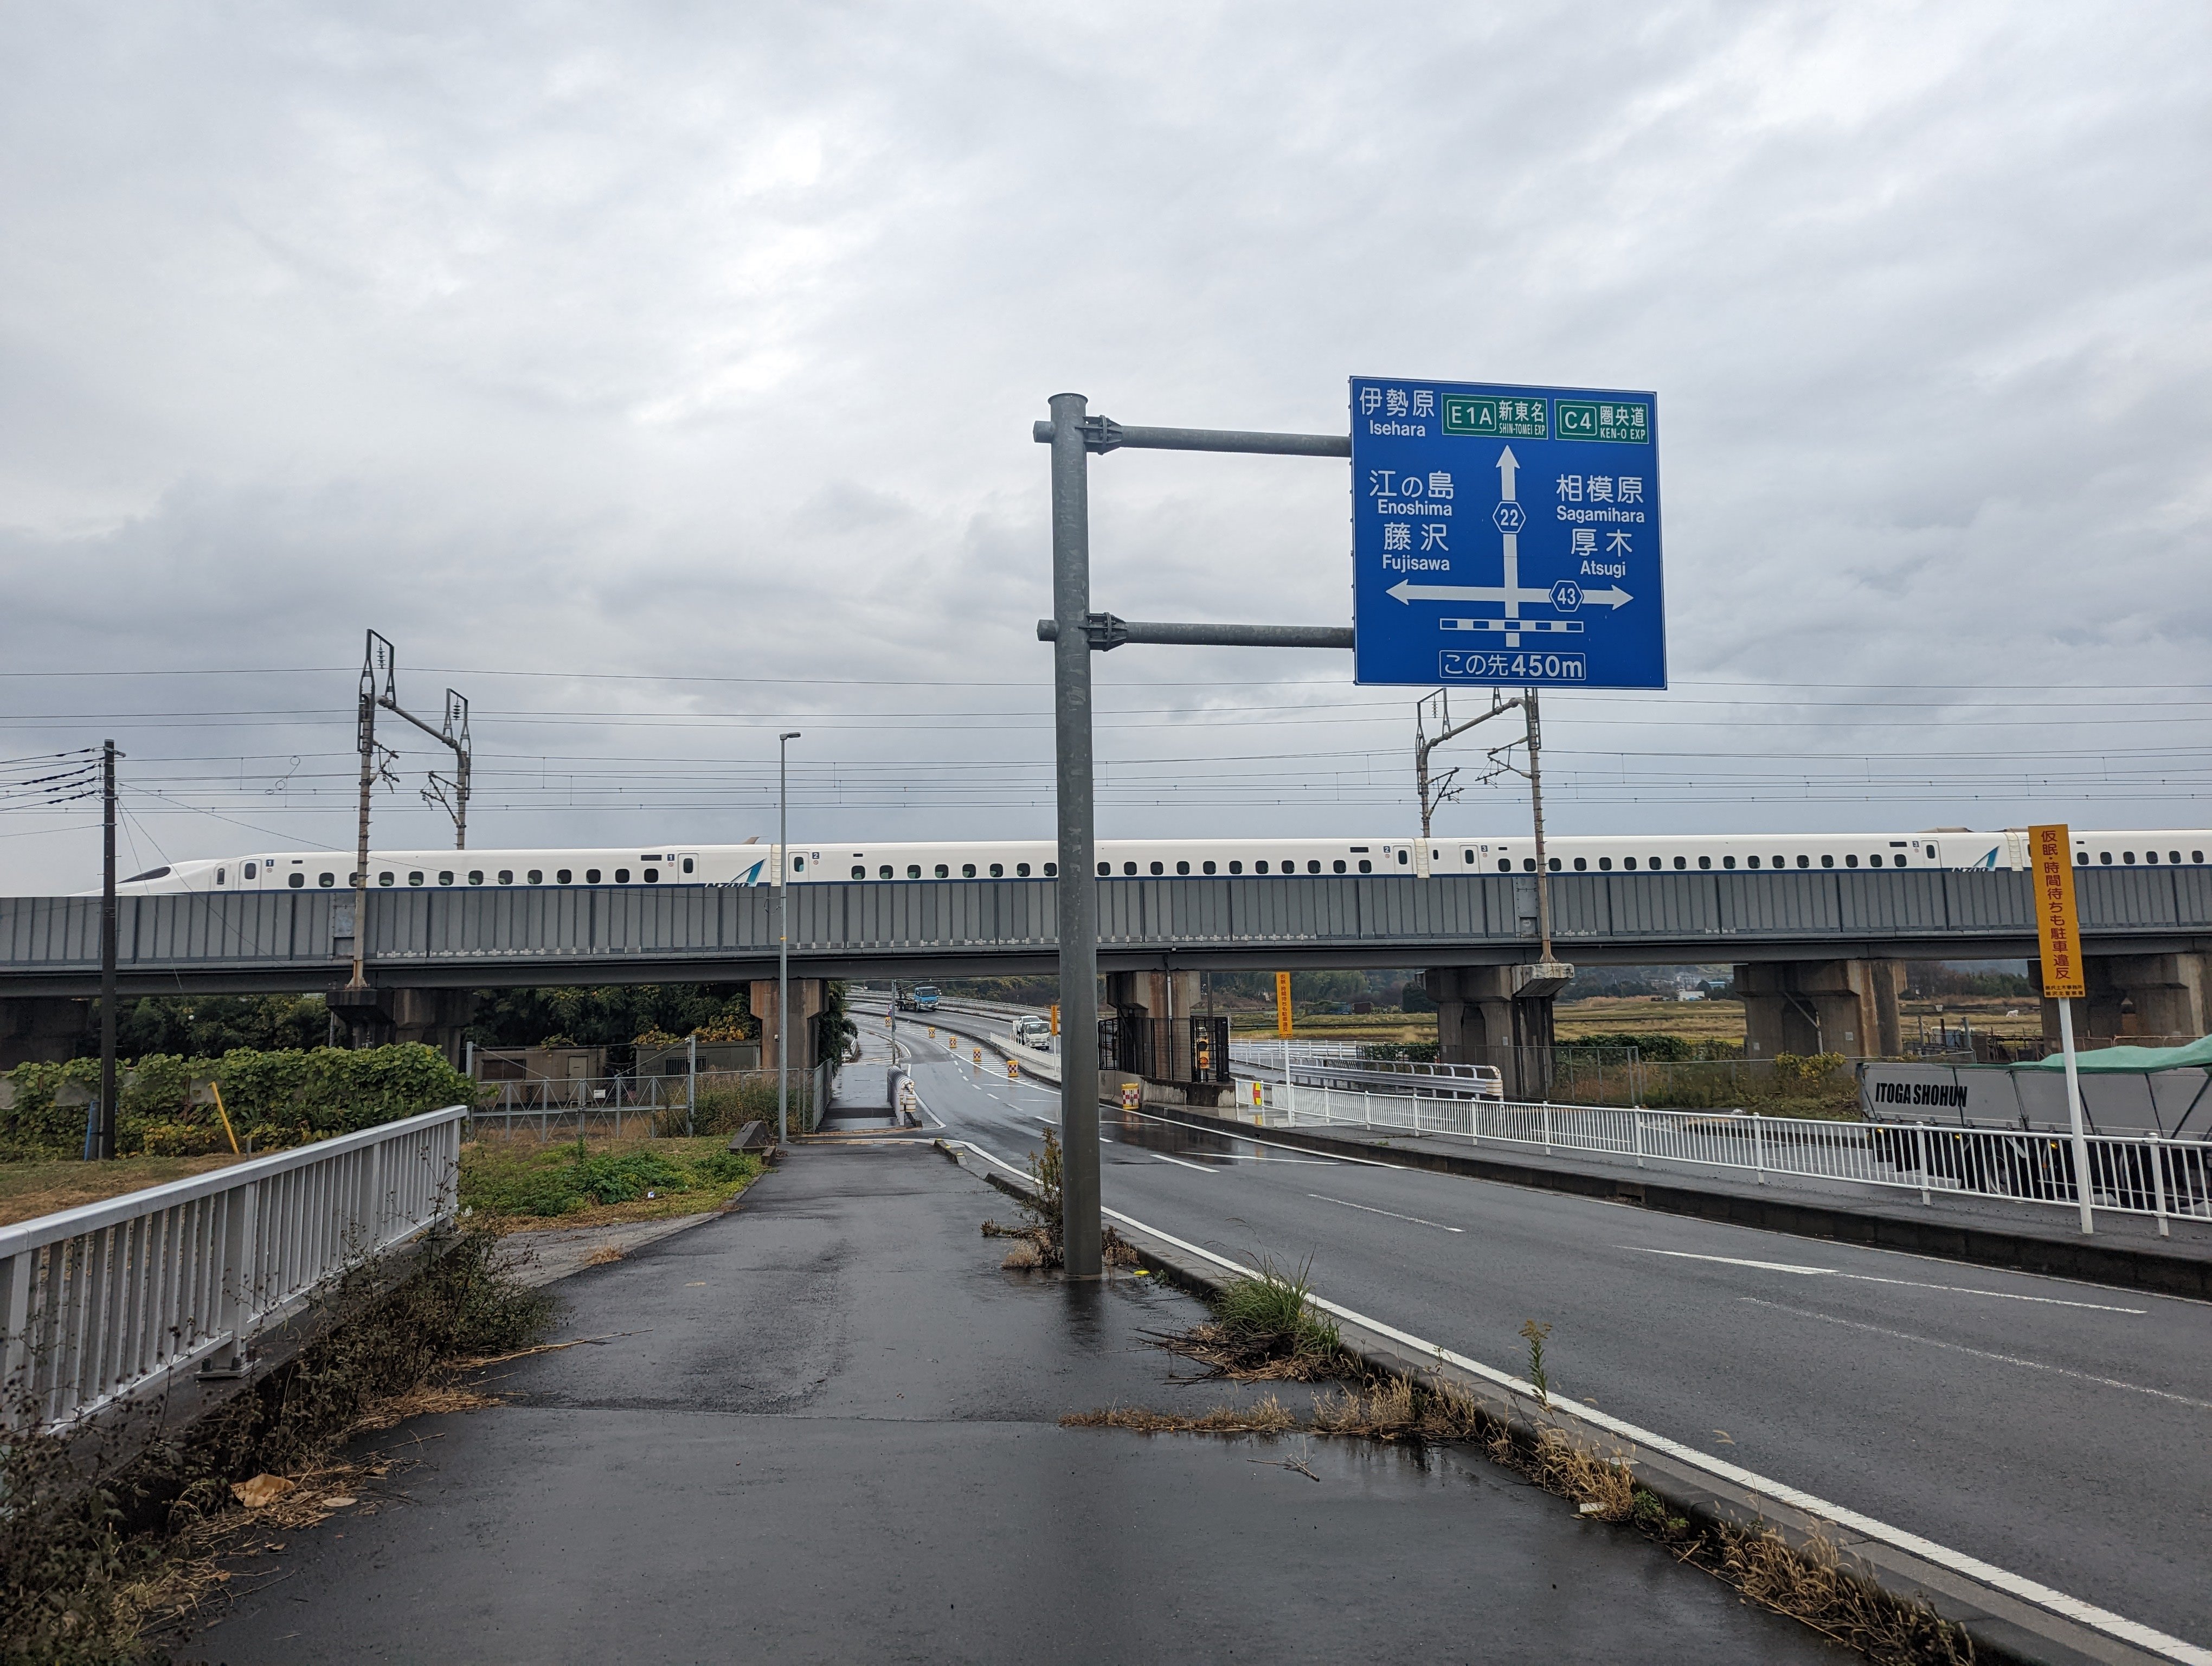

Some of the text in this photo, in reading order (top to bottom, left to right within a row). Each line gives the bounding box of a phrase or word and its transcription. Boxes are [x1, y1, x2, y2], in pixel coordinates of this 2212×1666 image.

[1359, 387, 1435, 418] 伊勢原
[1499, 400, 1544, 422] 新東名
[1451, 406, 1492, 425] E1A
[1565, 411, 1592, 430] C4
[1600, 406, 1645, 427] 圏央道
[1369, 420, 1426, 437] Isehara
[1499, 422, 1545, 435] SHIN-TOMEI EXP
[1600, 427, 1645, 440] KEN-O EXP
[1369, 470, 1454, 499] 江の島
[1556, 473, 1644, 504] 相模原
[1378, 499, 1452, 516] Enoshima
[1557, 505, 1645, 523] Sagamihara
[1500, 509, 1519, 526] 22
[1384, 522, 1449, 552] 藤沢
[1571, 528, 1632, 558] 厚木
[1382, 554, 1450, 573] Fujisawa
[1580, 560, 1626, 579] Atsugi
[1557, 587, 1576, 605] 43
[1444, 653, 1583, 678] この先450m
[2040, 830, 2071, 980] 仮眠・時間待ちも駐車違反
[1875, 1082, 1967, 1107] ITOGA SHOHUN
